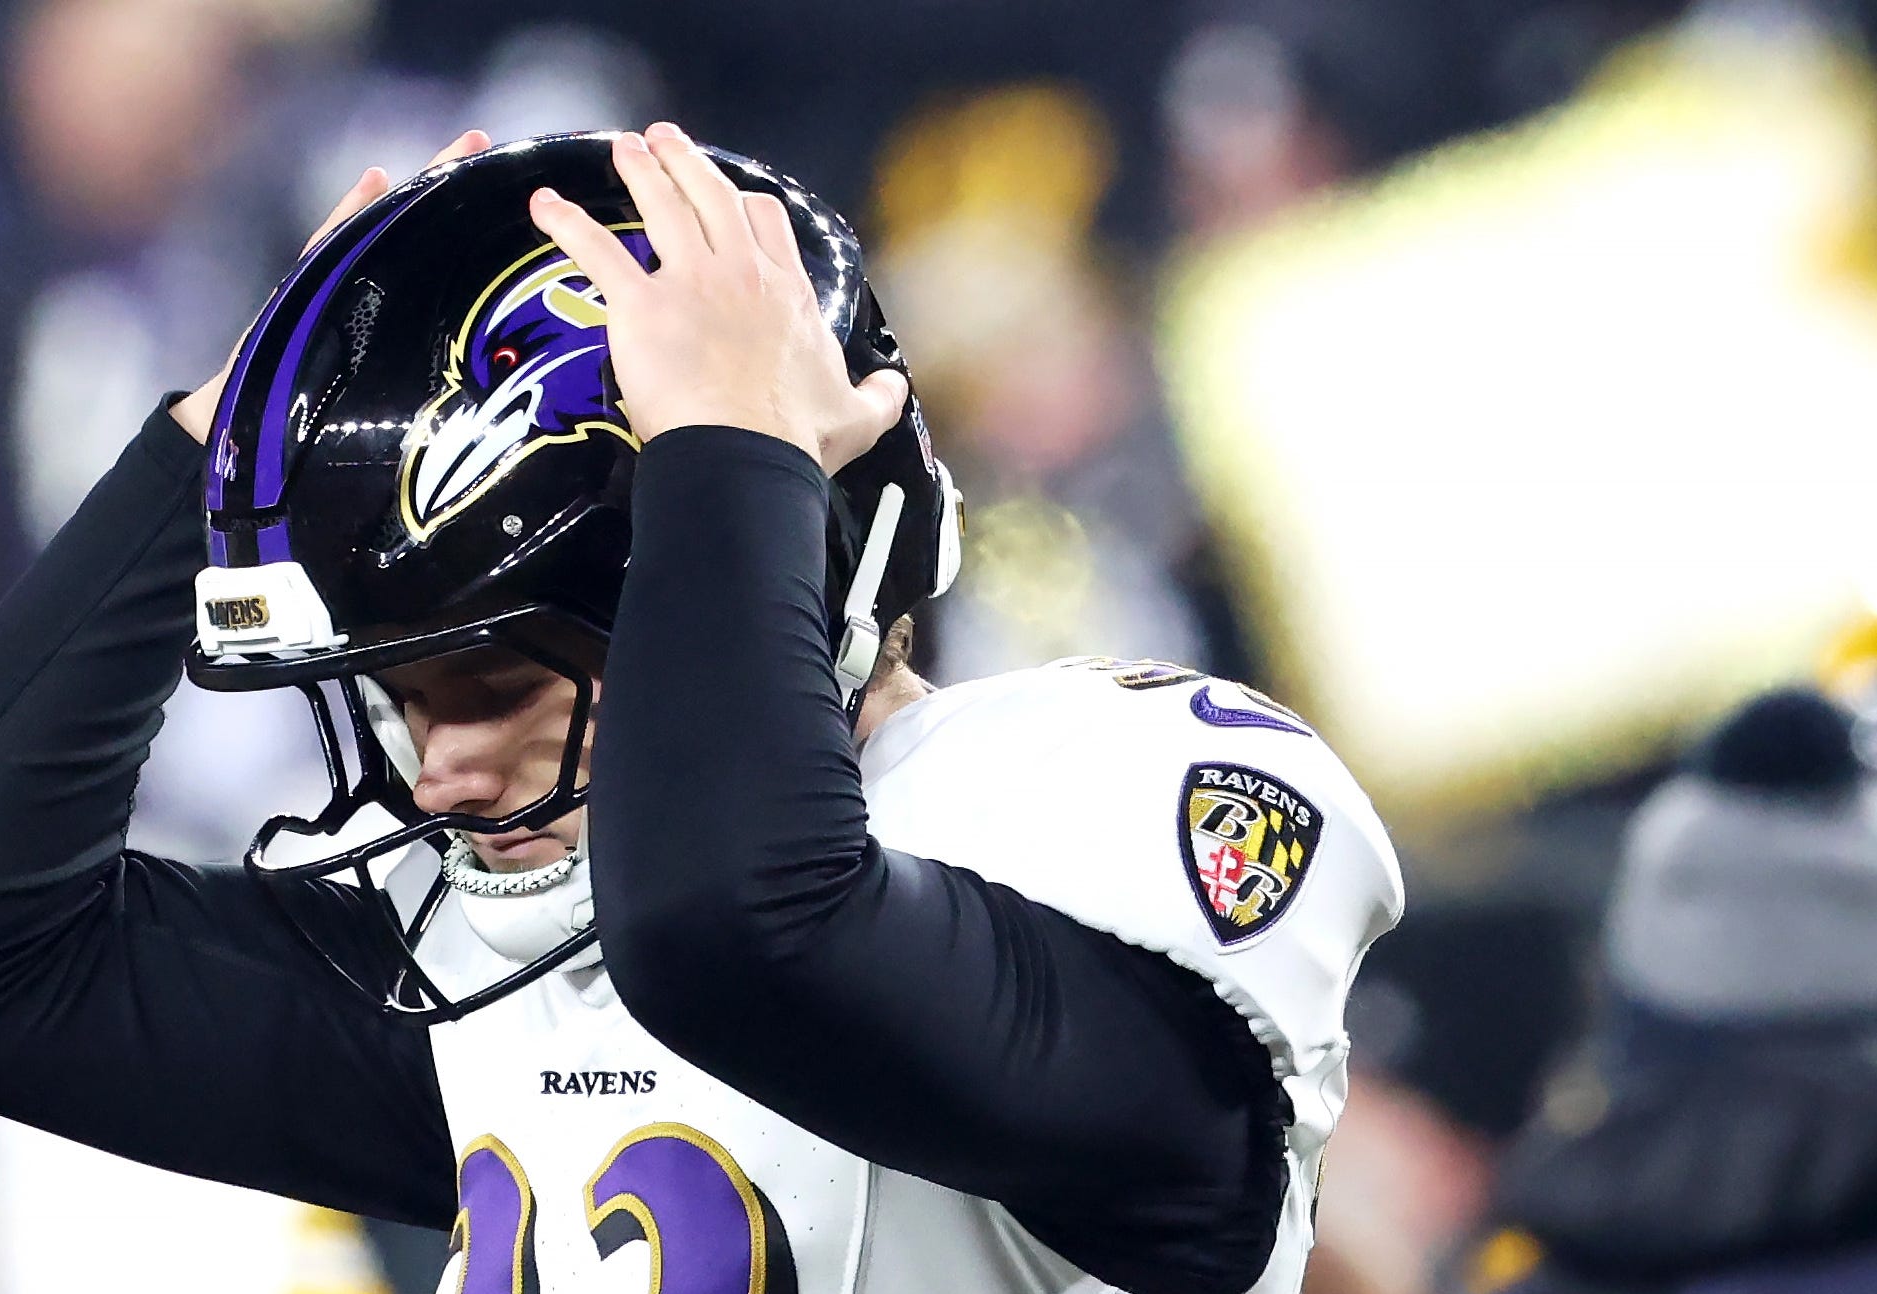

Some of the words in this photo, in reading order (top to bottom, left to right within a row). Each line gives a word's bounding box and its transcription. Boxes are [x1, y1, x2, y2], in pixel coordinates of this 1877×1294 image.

[205, 595, 270, 630] VENS
[1198, 768, 1312, 828] RAVENS
[540, 1069, 657, 1096] RAVENS
